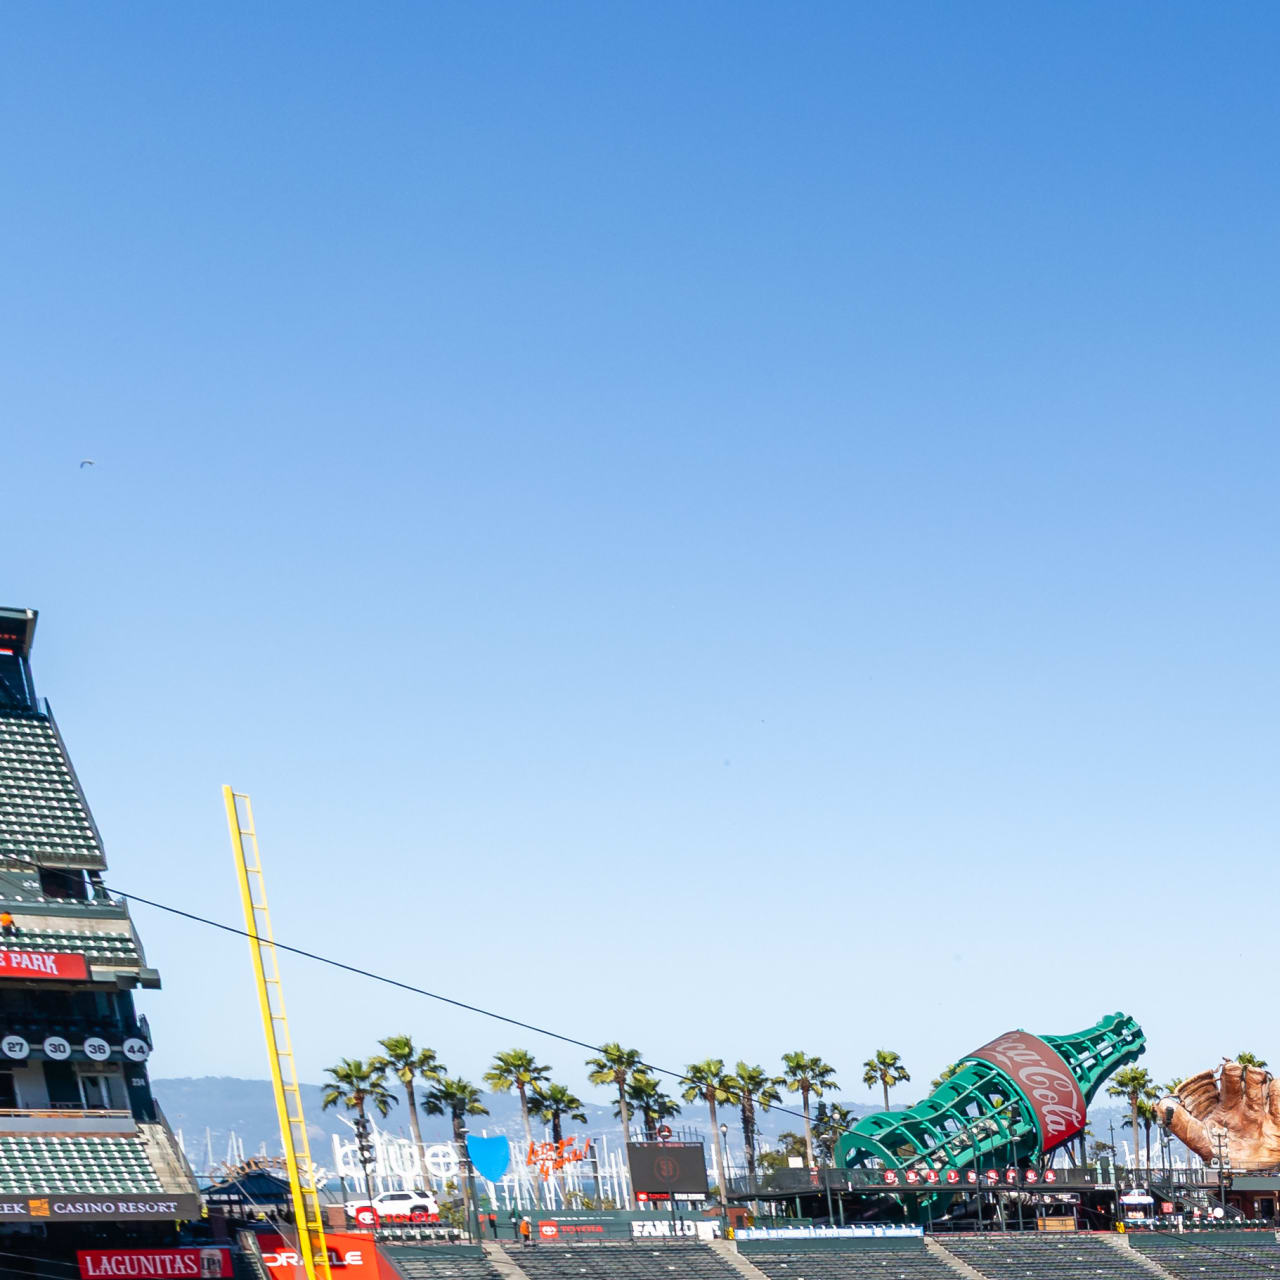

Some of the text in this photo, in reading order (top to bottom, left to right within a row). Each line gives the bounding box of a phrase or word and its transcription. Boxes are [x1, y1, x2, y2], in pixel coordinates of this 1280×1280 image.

[11, 952, 58, 975] PARK
[7, 1042, 25, 1053] 27
[49, 1043, 67, 1054] 30
[88, 1043, 107, 1055] 36
[127, 1044, 146, 1056] 44
[53, 1202, 116, 1214] CASINO
[117, 1201, 178, 1214] RESORT
[385, 1212, 440, 1224] TOYOTA
[85, 1253, 199, 1277] LAGUNITAS
